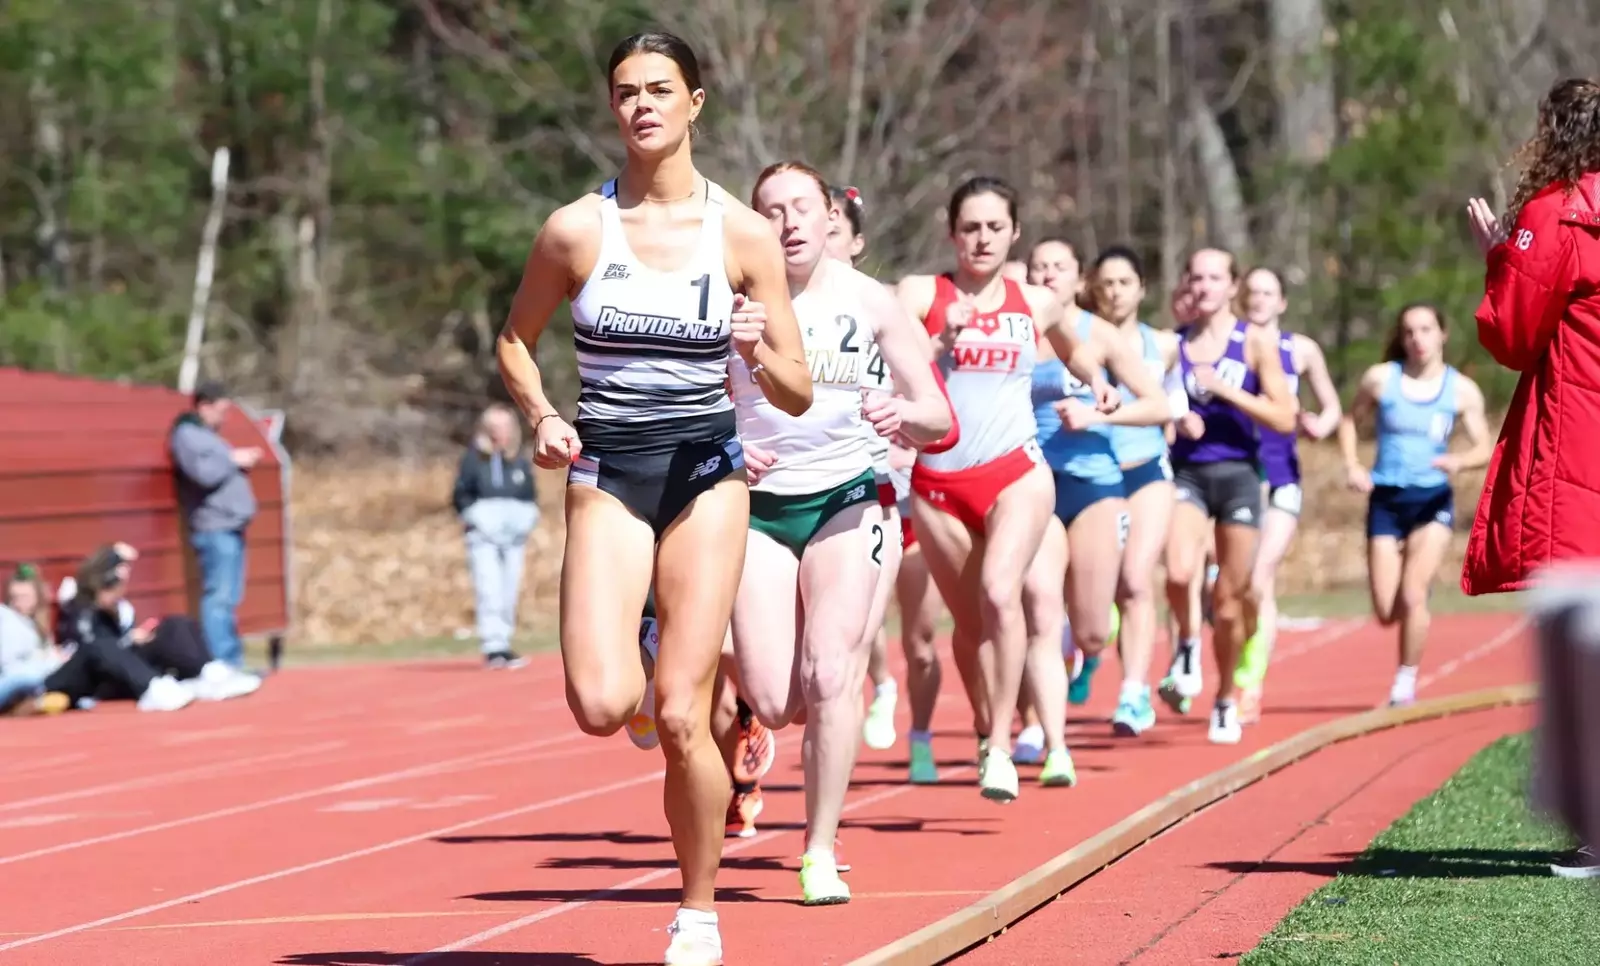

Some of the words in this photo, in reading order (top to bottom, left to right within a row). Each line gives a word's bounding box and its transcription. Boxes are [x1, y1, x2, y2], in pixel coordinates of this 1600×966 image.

[1515, 228, 1533, 251] 18
[603, 270, 631, 278] EAST
[607, 263, 628, 271] BIG
[690, 273, 710, 321] 1
[835, 314, 859, 352] 2
[1005, 316, 1030, 341] 13
[866, 350, 885, 385] 4
[953, 347, 1020, 369] WPI
[871, 524, 883, 566] 2
